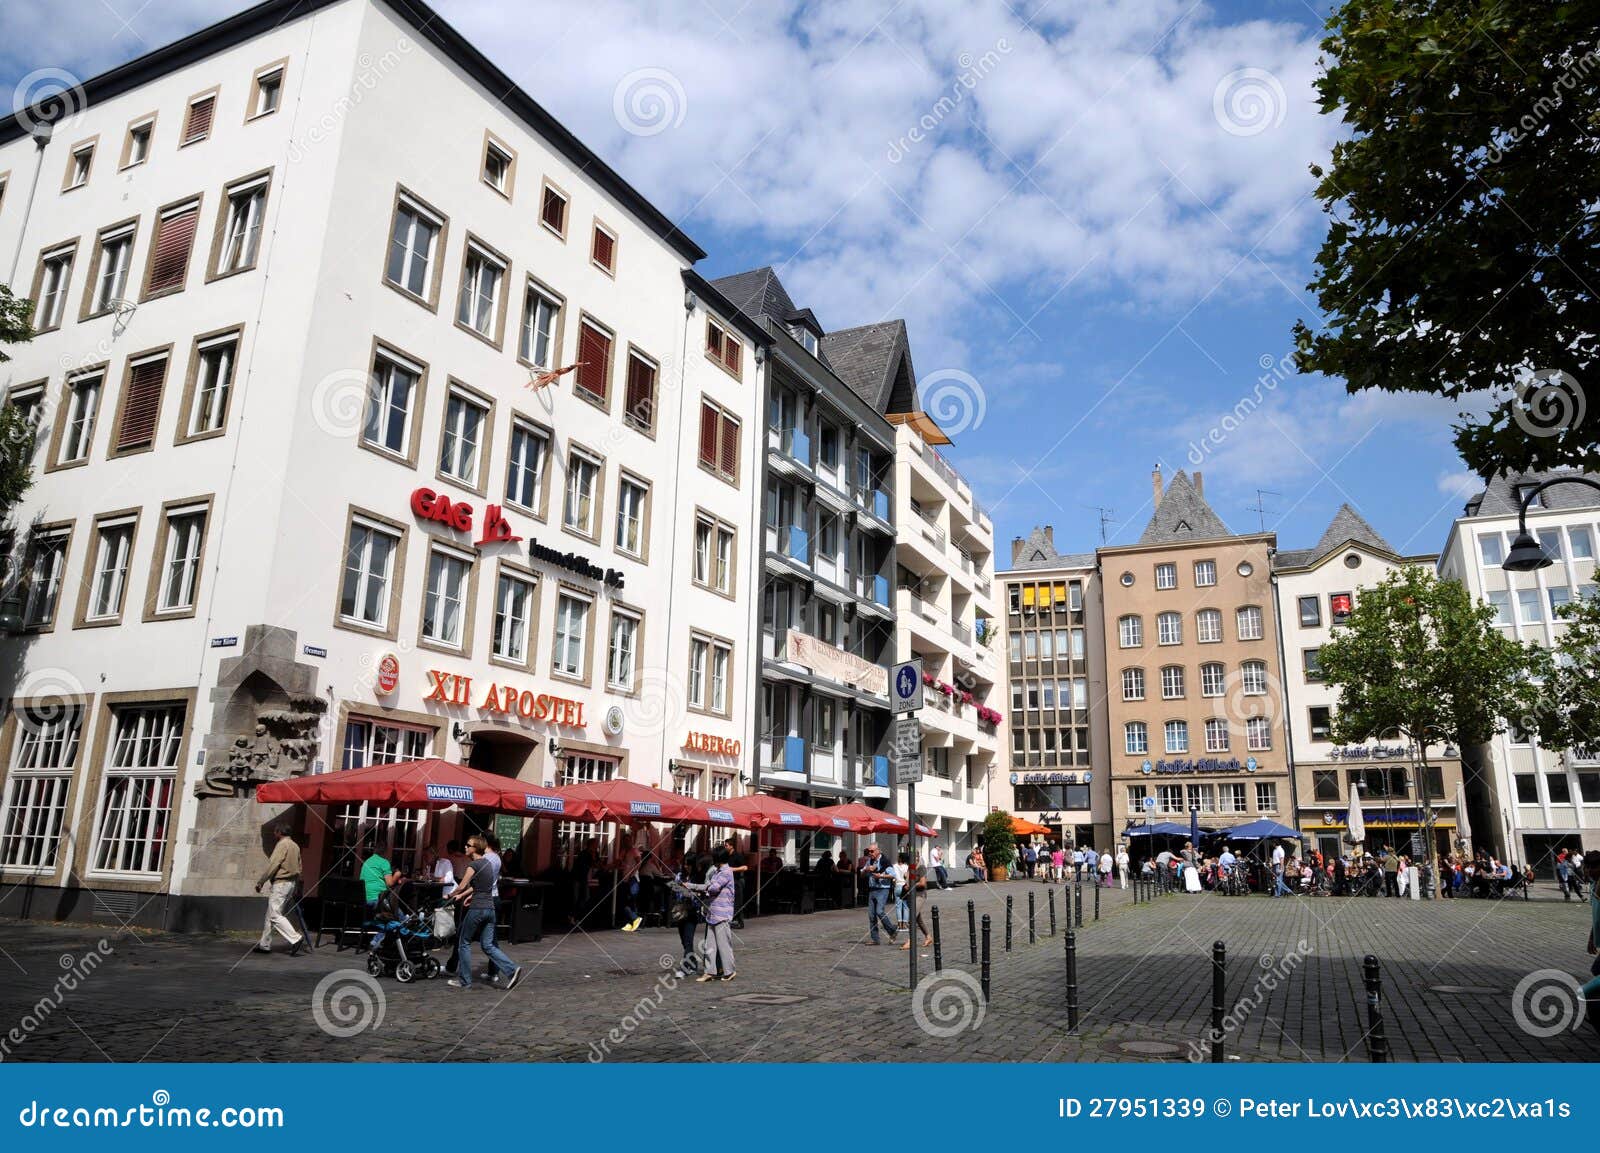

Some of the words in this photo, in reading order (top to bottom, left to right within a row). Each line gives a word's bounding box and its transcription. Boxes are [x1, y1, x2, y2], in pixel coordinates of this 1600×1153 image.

[410, 488, 473, 532] GAG
[426, 669, 473, 706] XII
[481, 682, 588, 729] APOSTEL
[898, 699, 915, 712] ZONE
[684, 730, 741, 757] ALBERGO
[427, 785, 473, 802] RAMAZZOTTI
[526, 796, 564, 811] RAMAZZOTTI
[631, 802, 660, 815] RAMAZZOTTI
